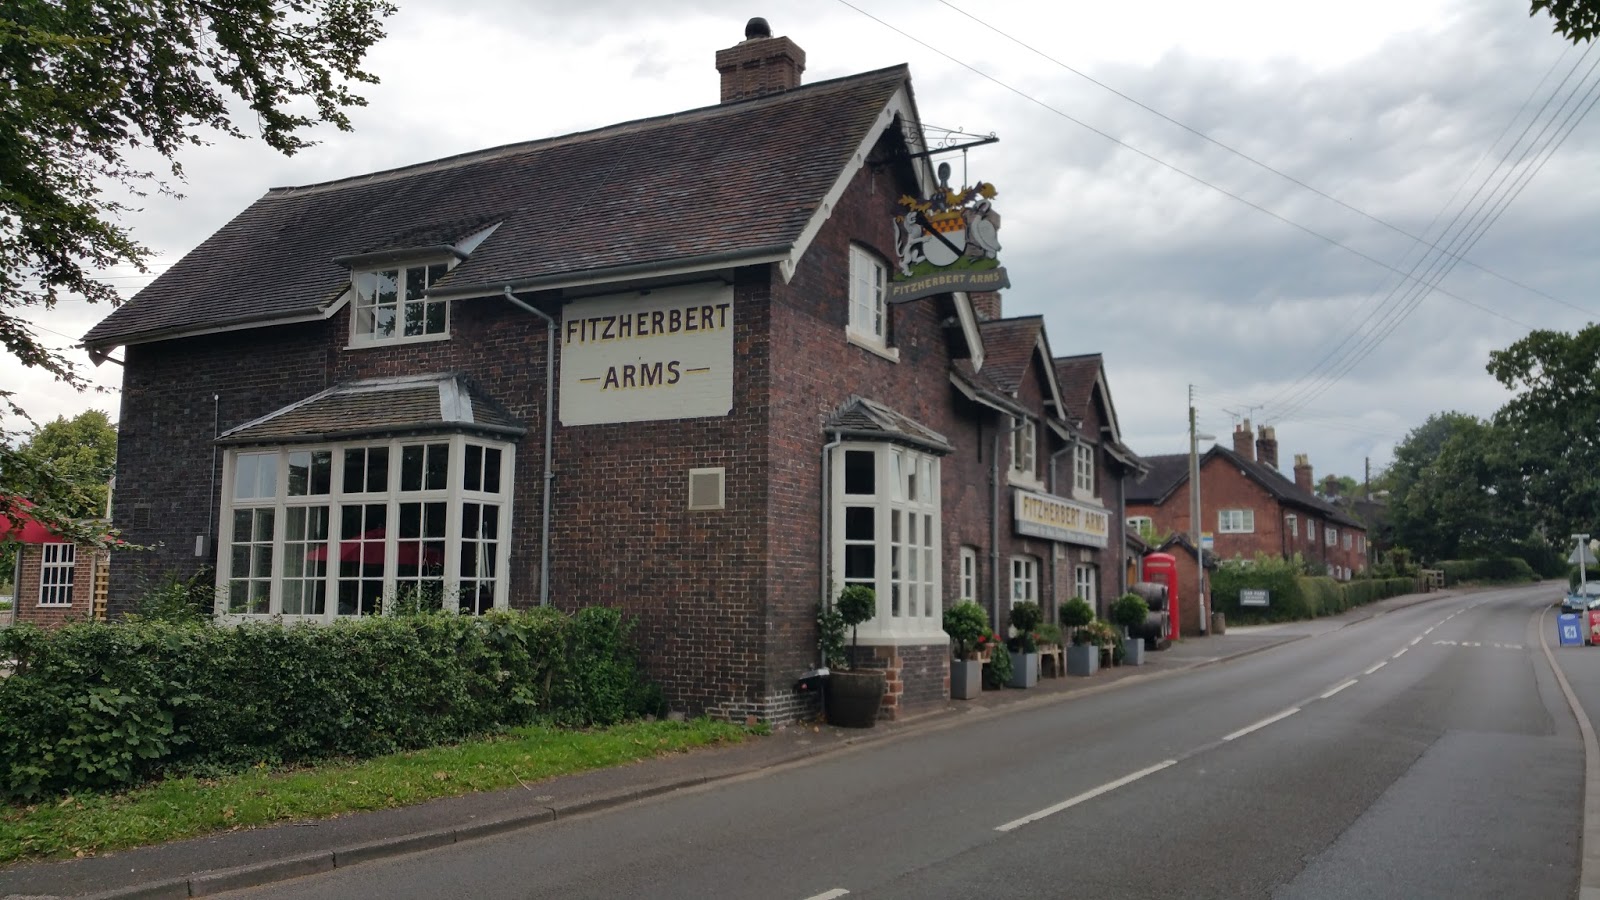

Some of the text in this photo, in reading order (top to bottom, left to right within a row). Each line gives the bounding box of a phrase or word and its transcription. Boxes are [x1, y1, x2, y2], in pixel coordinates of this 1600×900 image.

[892, 272, 1000, 296] FITZHERBERT ARMS
[566, 303, 730, 345] FITZHERBERT
[602, 360, 681, 391] ARMS
[1023, 495, 1105, 533] FITZHERBERT ARMS
